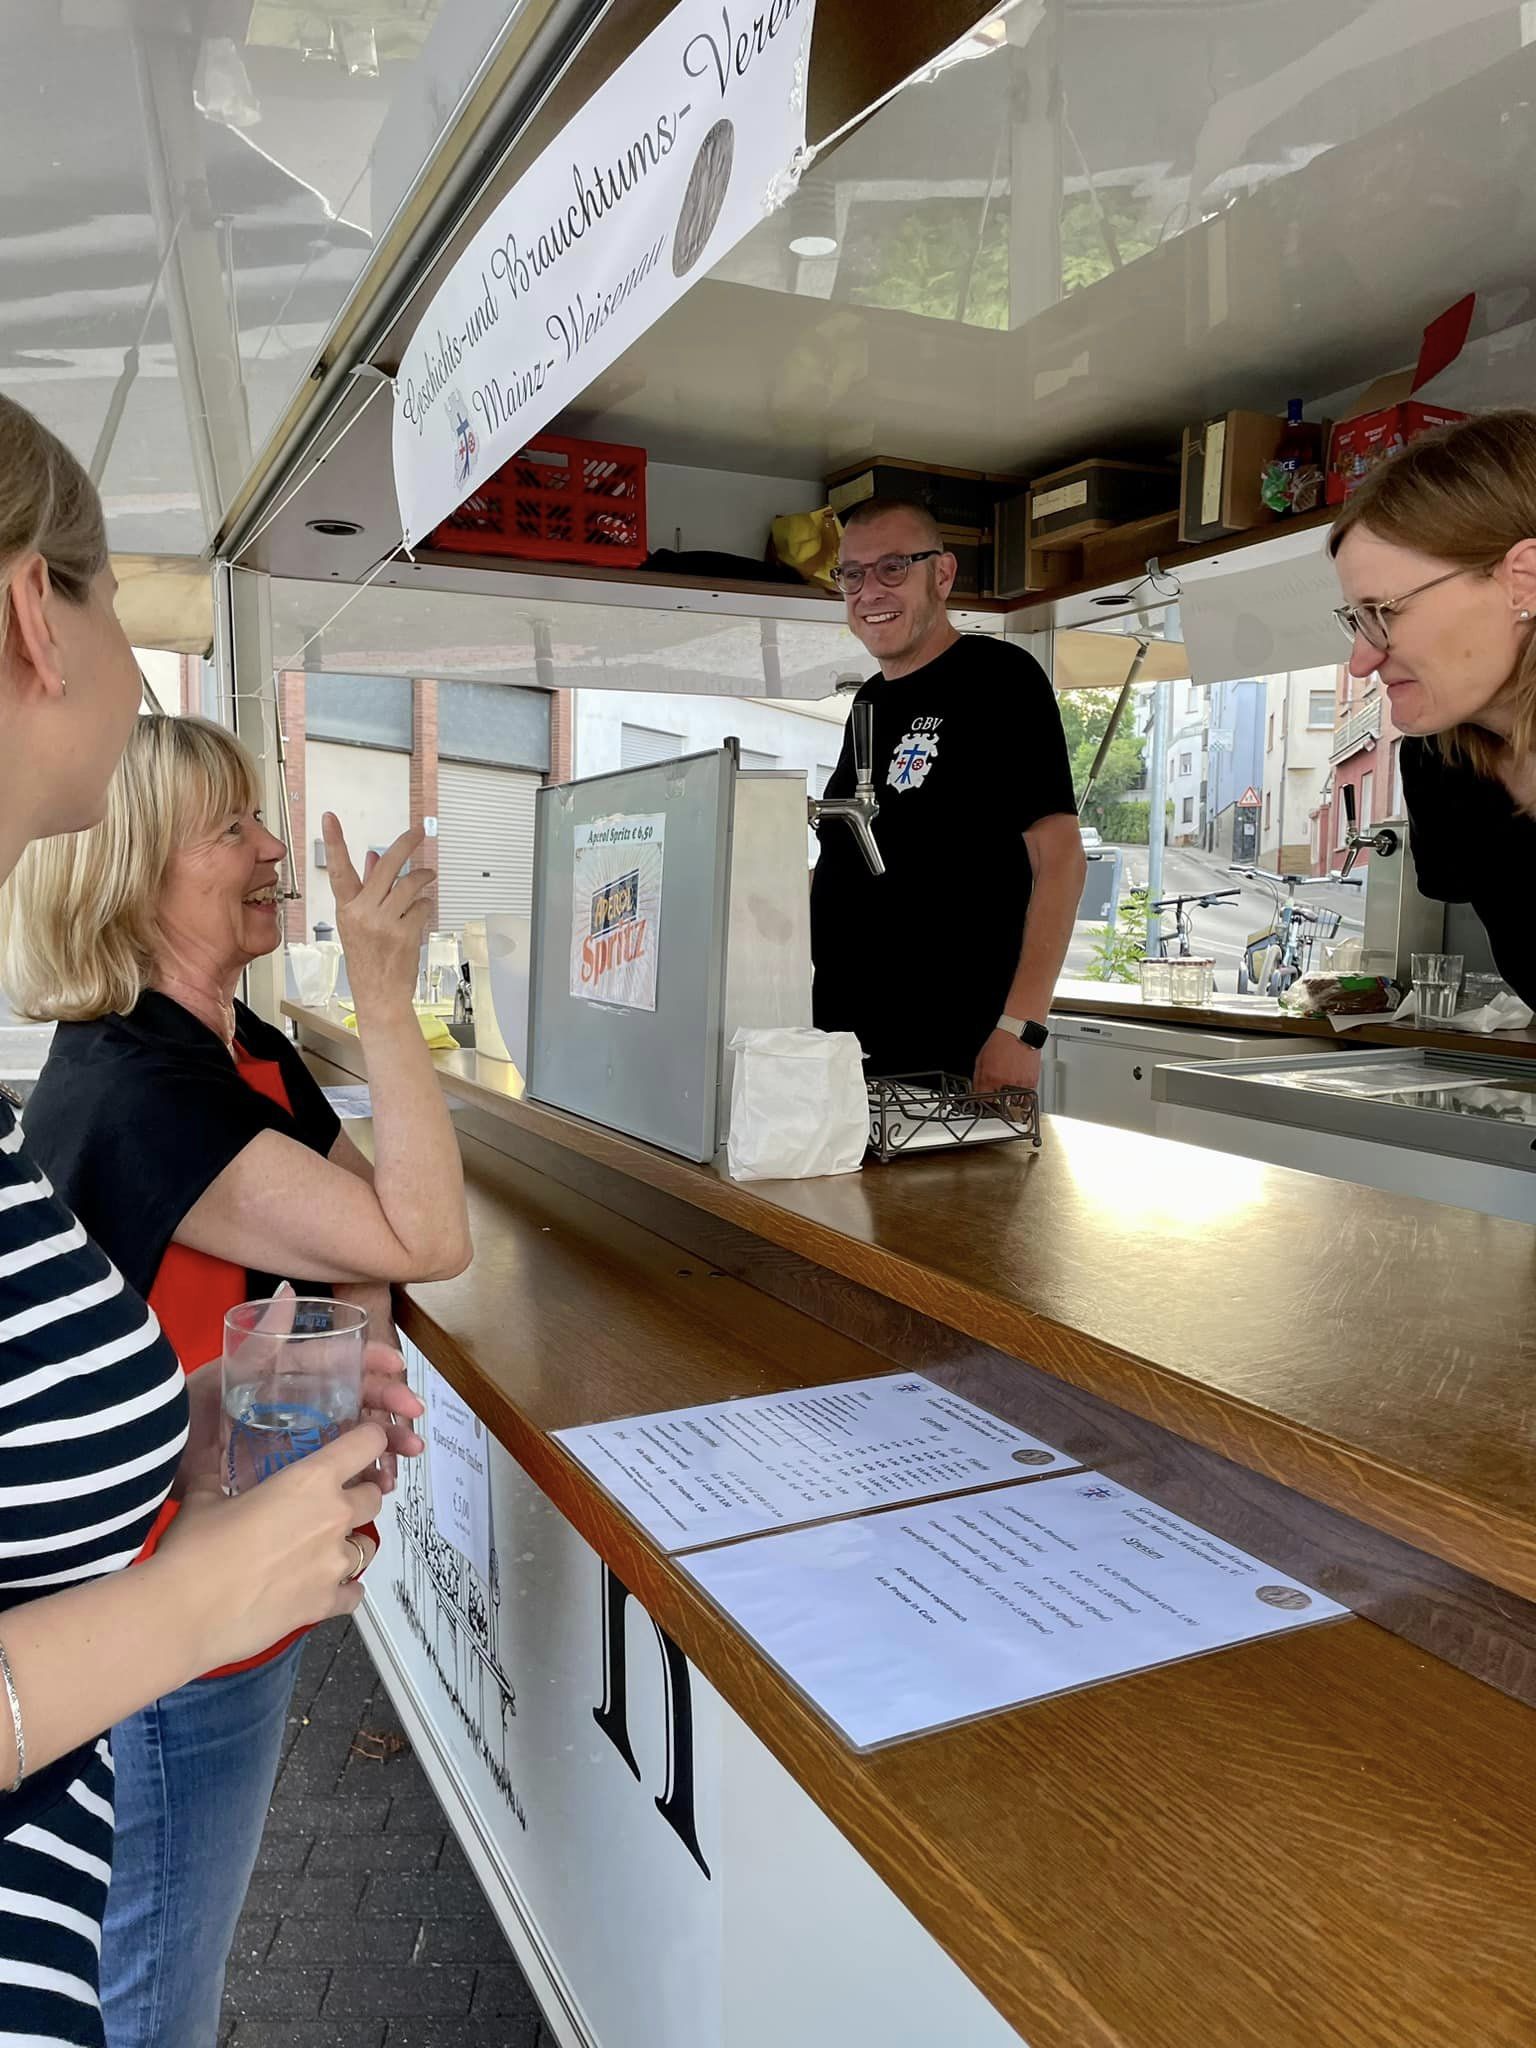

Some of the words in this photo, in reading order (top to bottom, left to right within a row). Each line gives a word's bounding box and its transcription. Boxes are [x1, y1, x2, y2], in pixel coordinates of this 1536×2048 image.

[683, 0, 800, 99] Vere
[911, 716, 943, 731] GBV
[587, 829, 609, 846] Aperol
[609, 827, 631, 844] Spritz
[637, 826, 653, 841] 6,50
[595, 888, 635, 928] APEROL
[1118, 1535, 1168, 1560] Speisen
